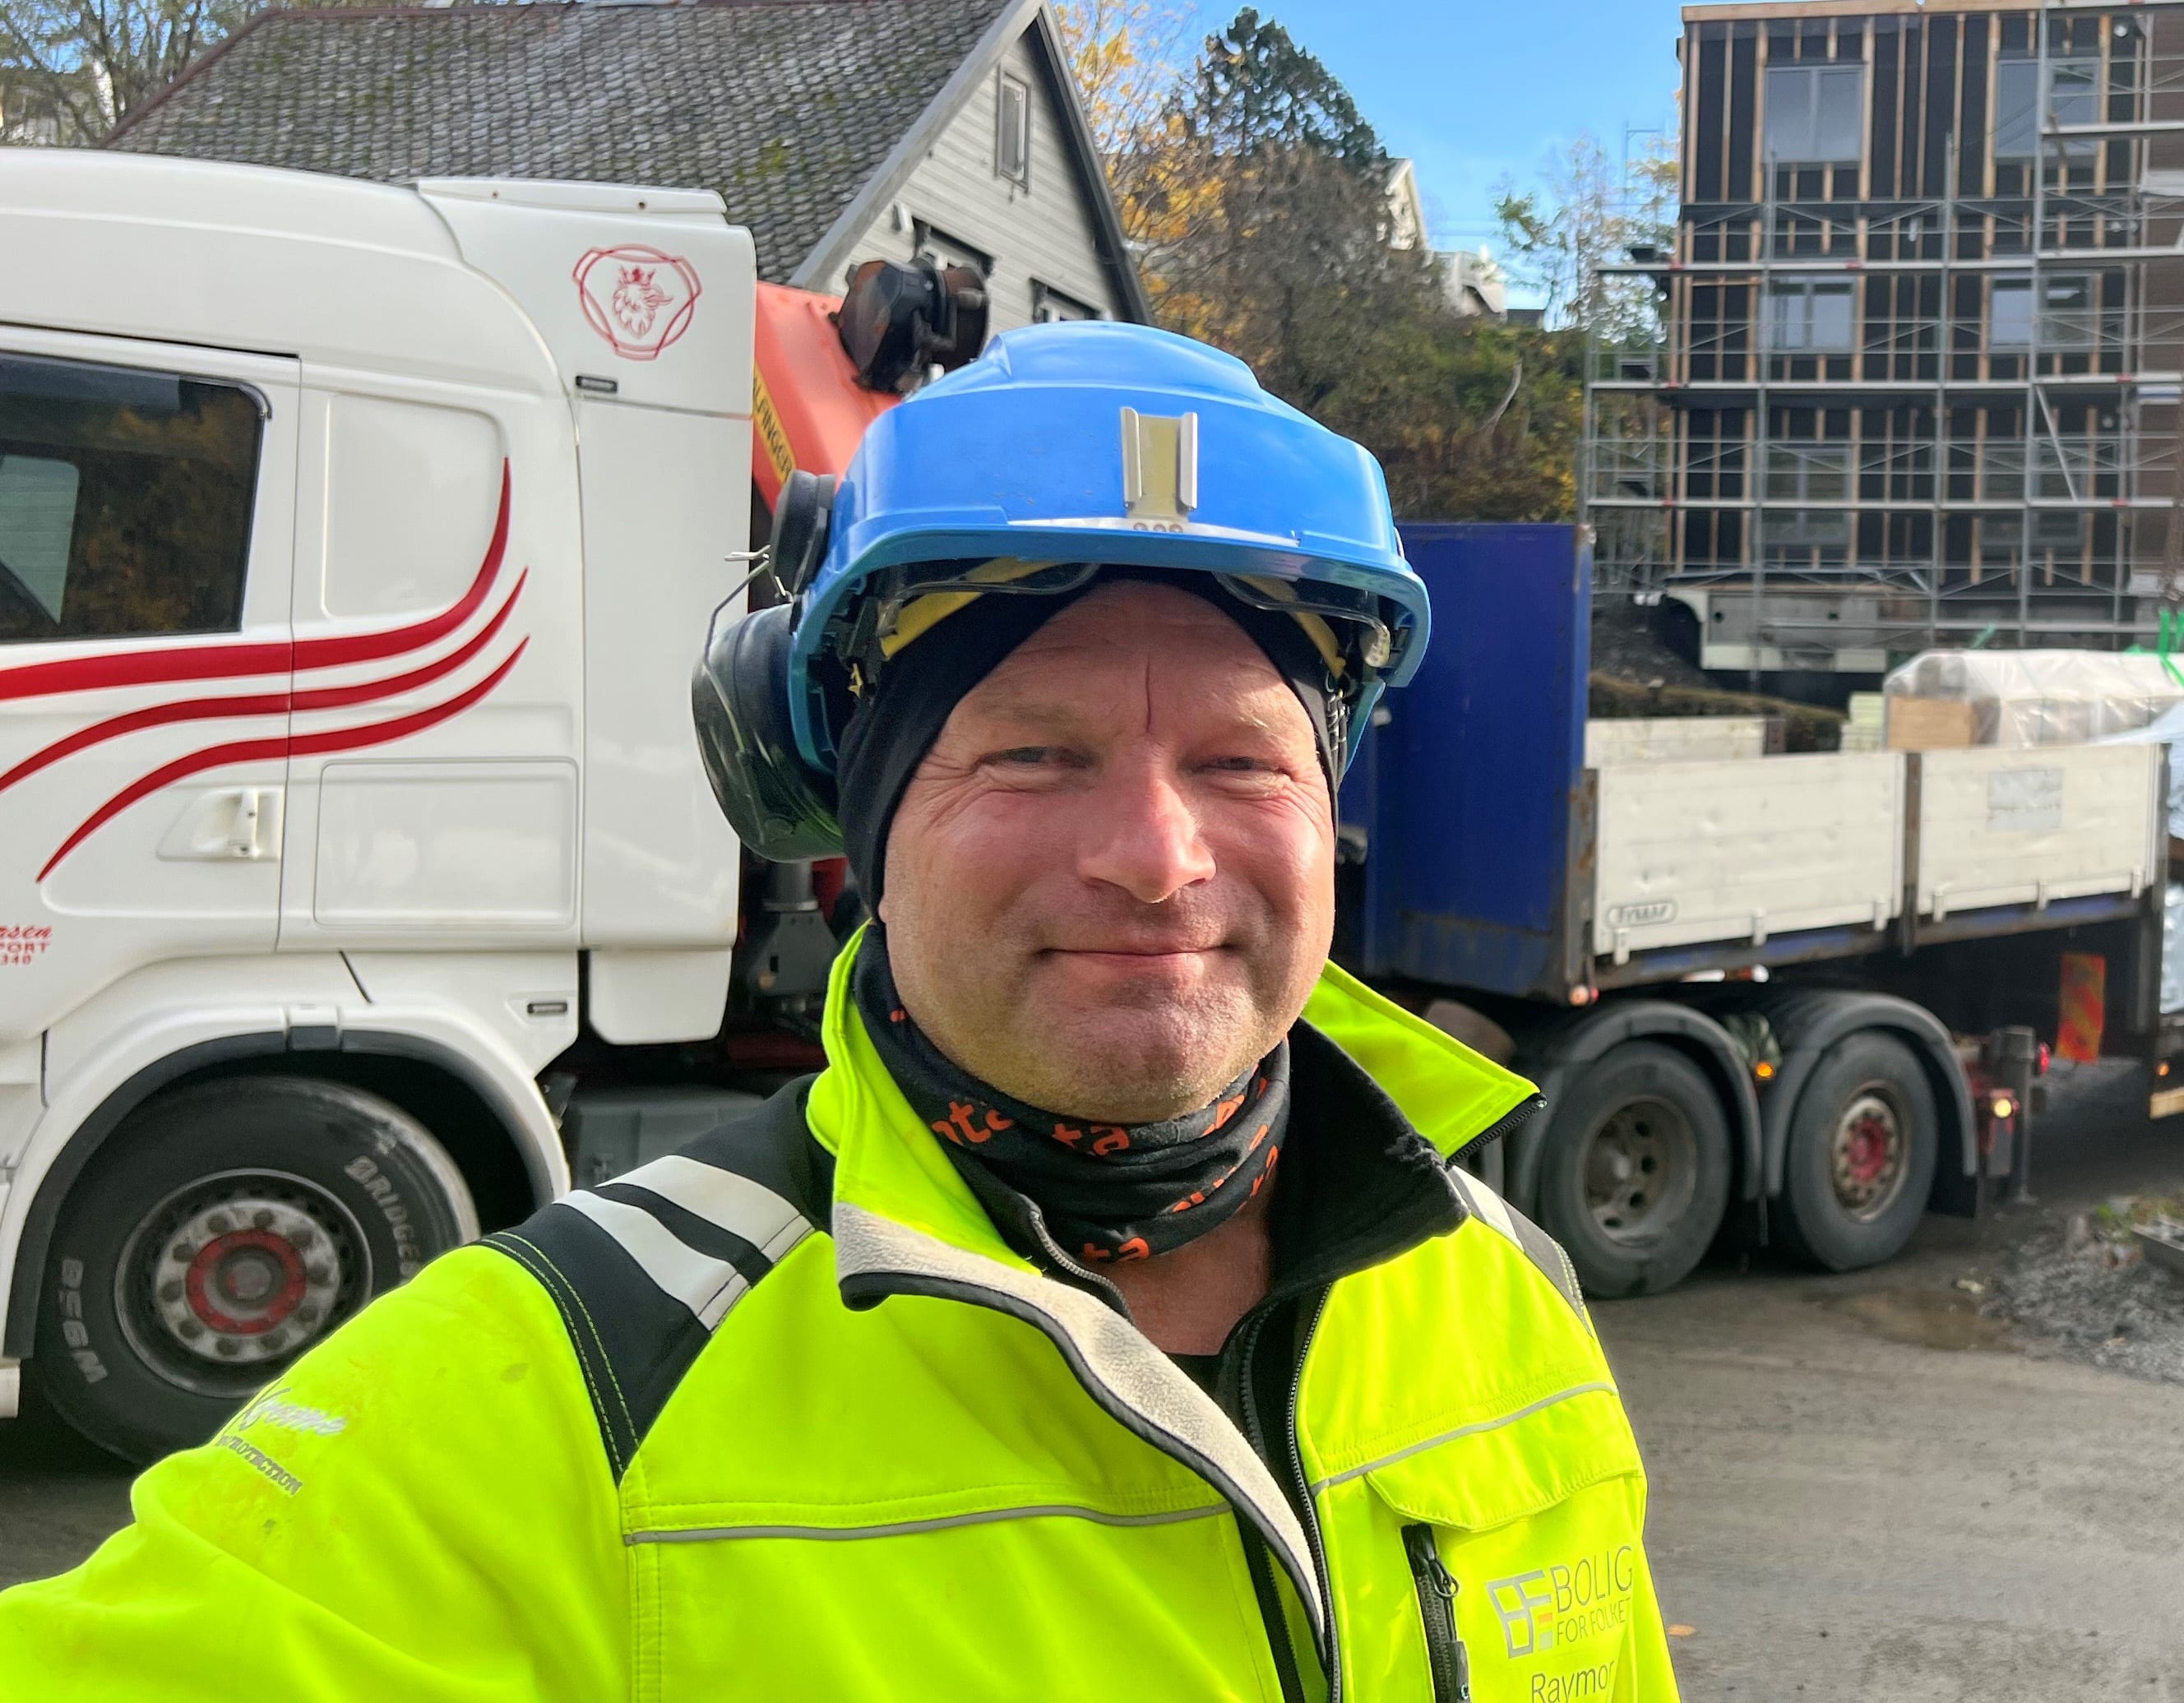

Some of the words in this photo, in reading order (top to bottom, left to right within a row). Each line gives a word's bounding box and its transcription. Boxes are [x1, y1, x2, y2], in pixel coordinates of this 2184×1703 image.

[344, 1155, 422, 1284] BRIDGES
[1549, 1545, 1632, 1613] BOLIG
[1557, 1615, 1588, 1646] FOR
